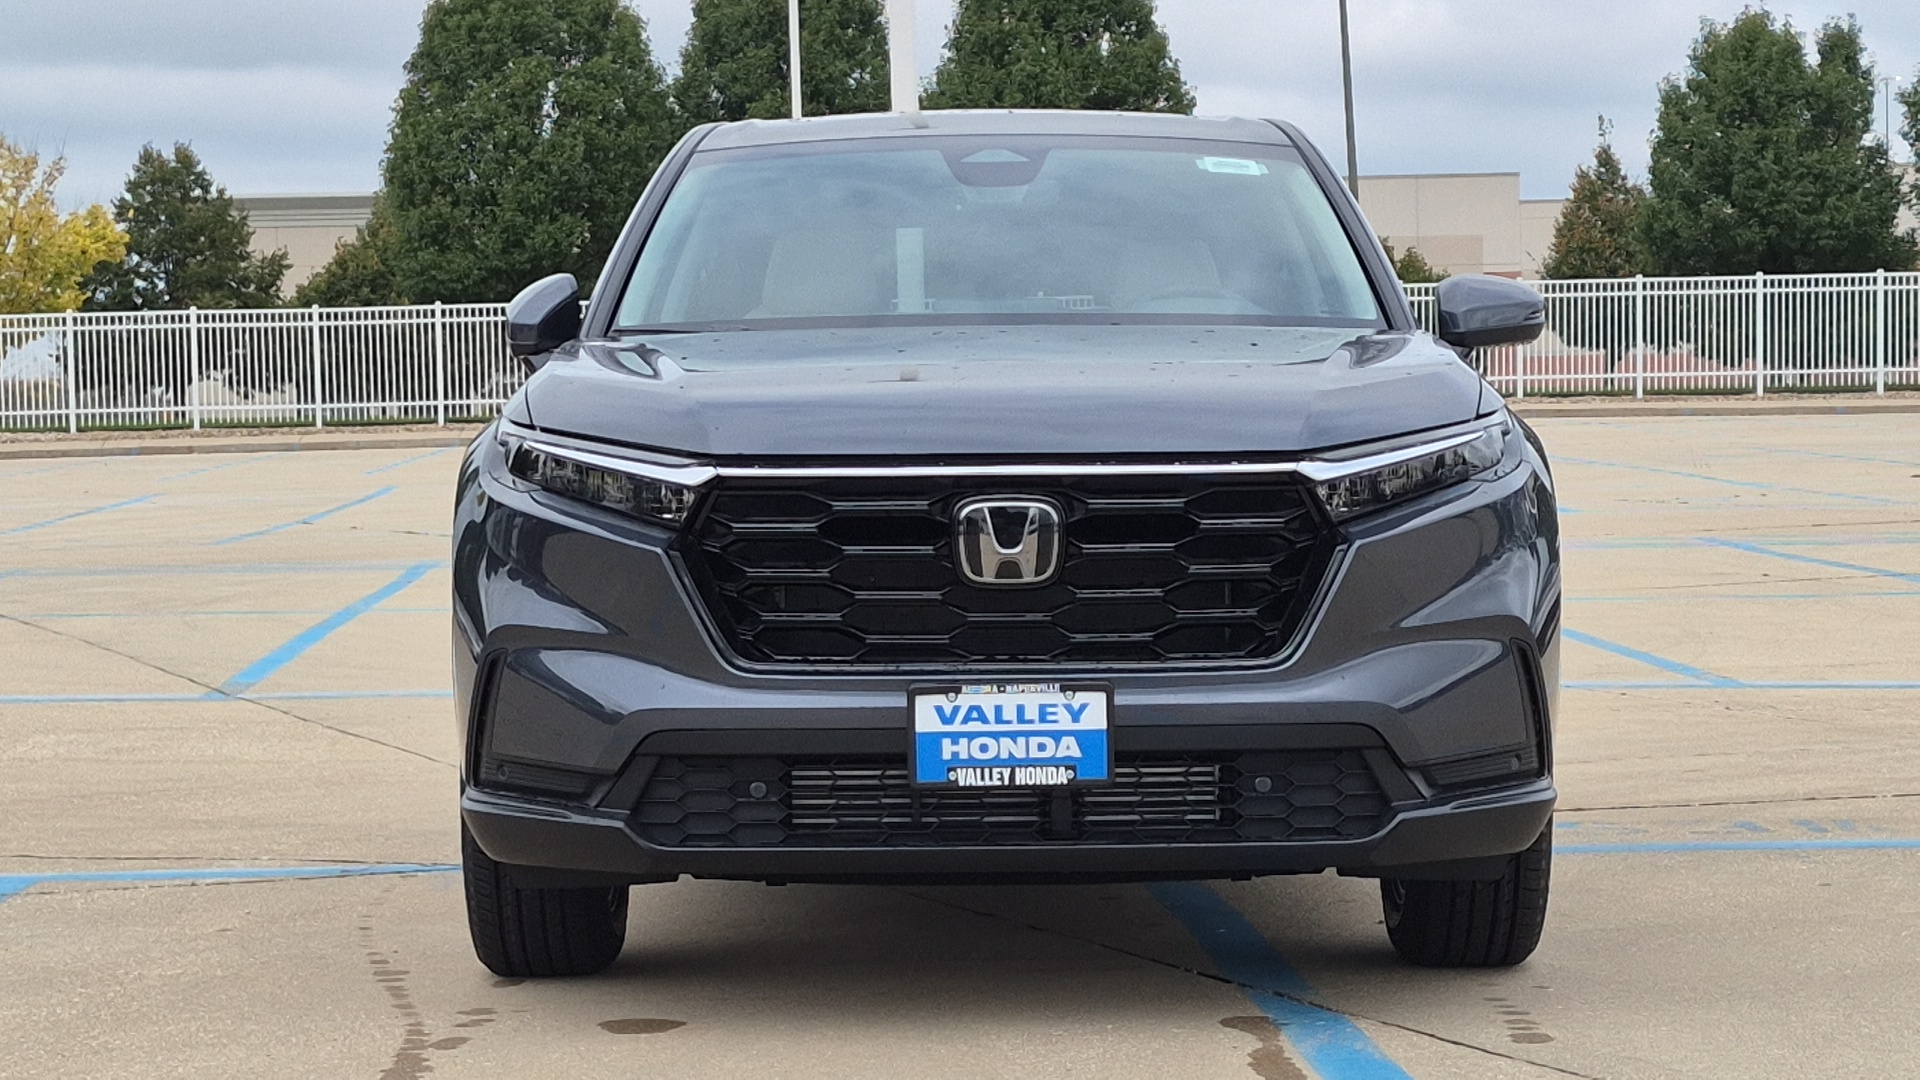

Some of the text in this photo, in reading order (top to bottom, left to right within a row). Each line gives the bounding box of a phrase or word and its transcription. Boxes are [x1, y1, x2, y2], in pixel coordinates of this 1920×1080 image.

[933, 702, 1090, 726] VALLEY
[942, 736, 1082, 760] HONDA
[957, 766, 1068, 786] VALLEY HONDA
